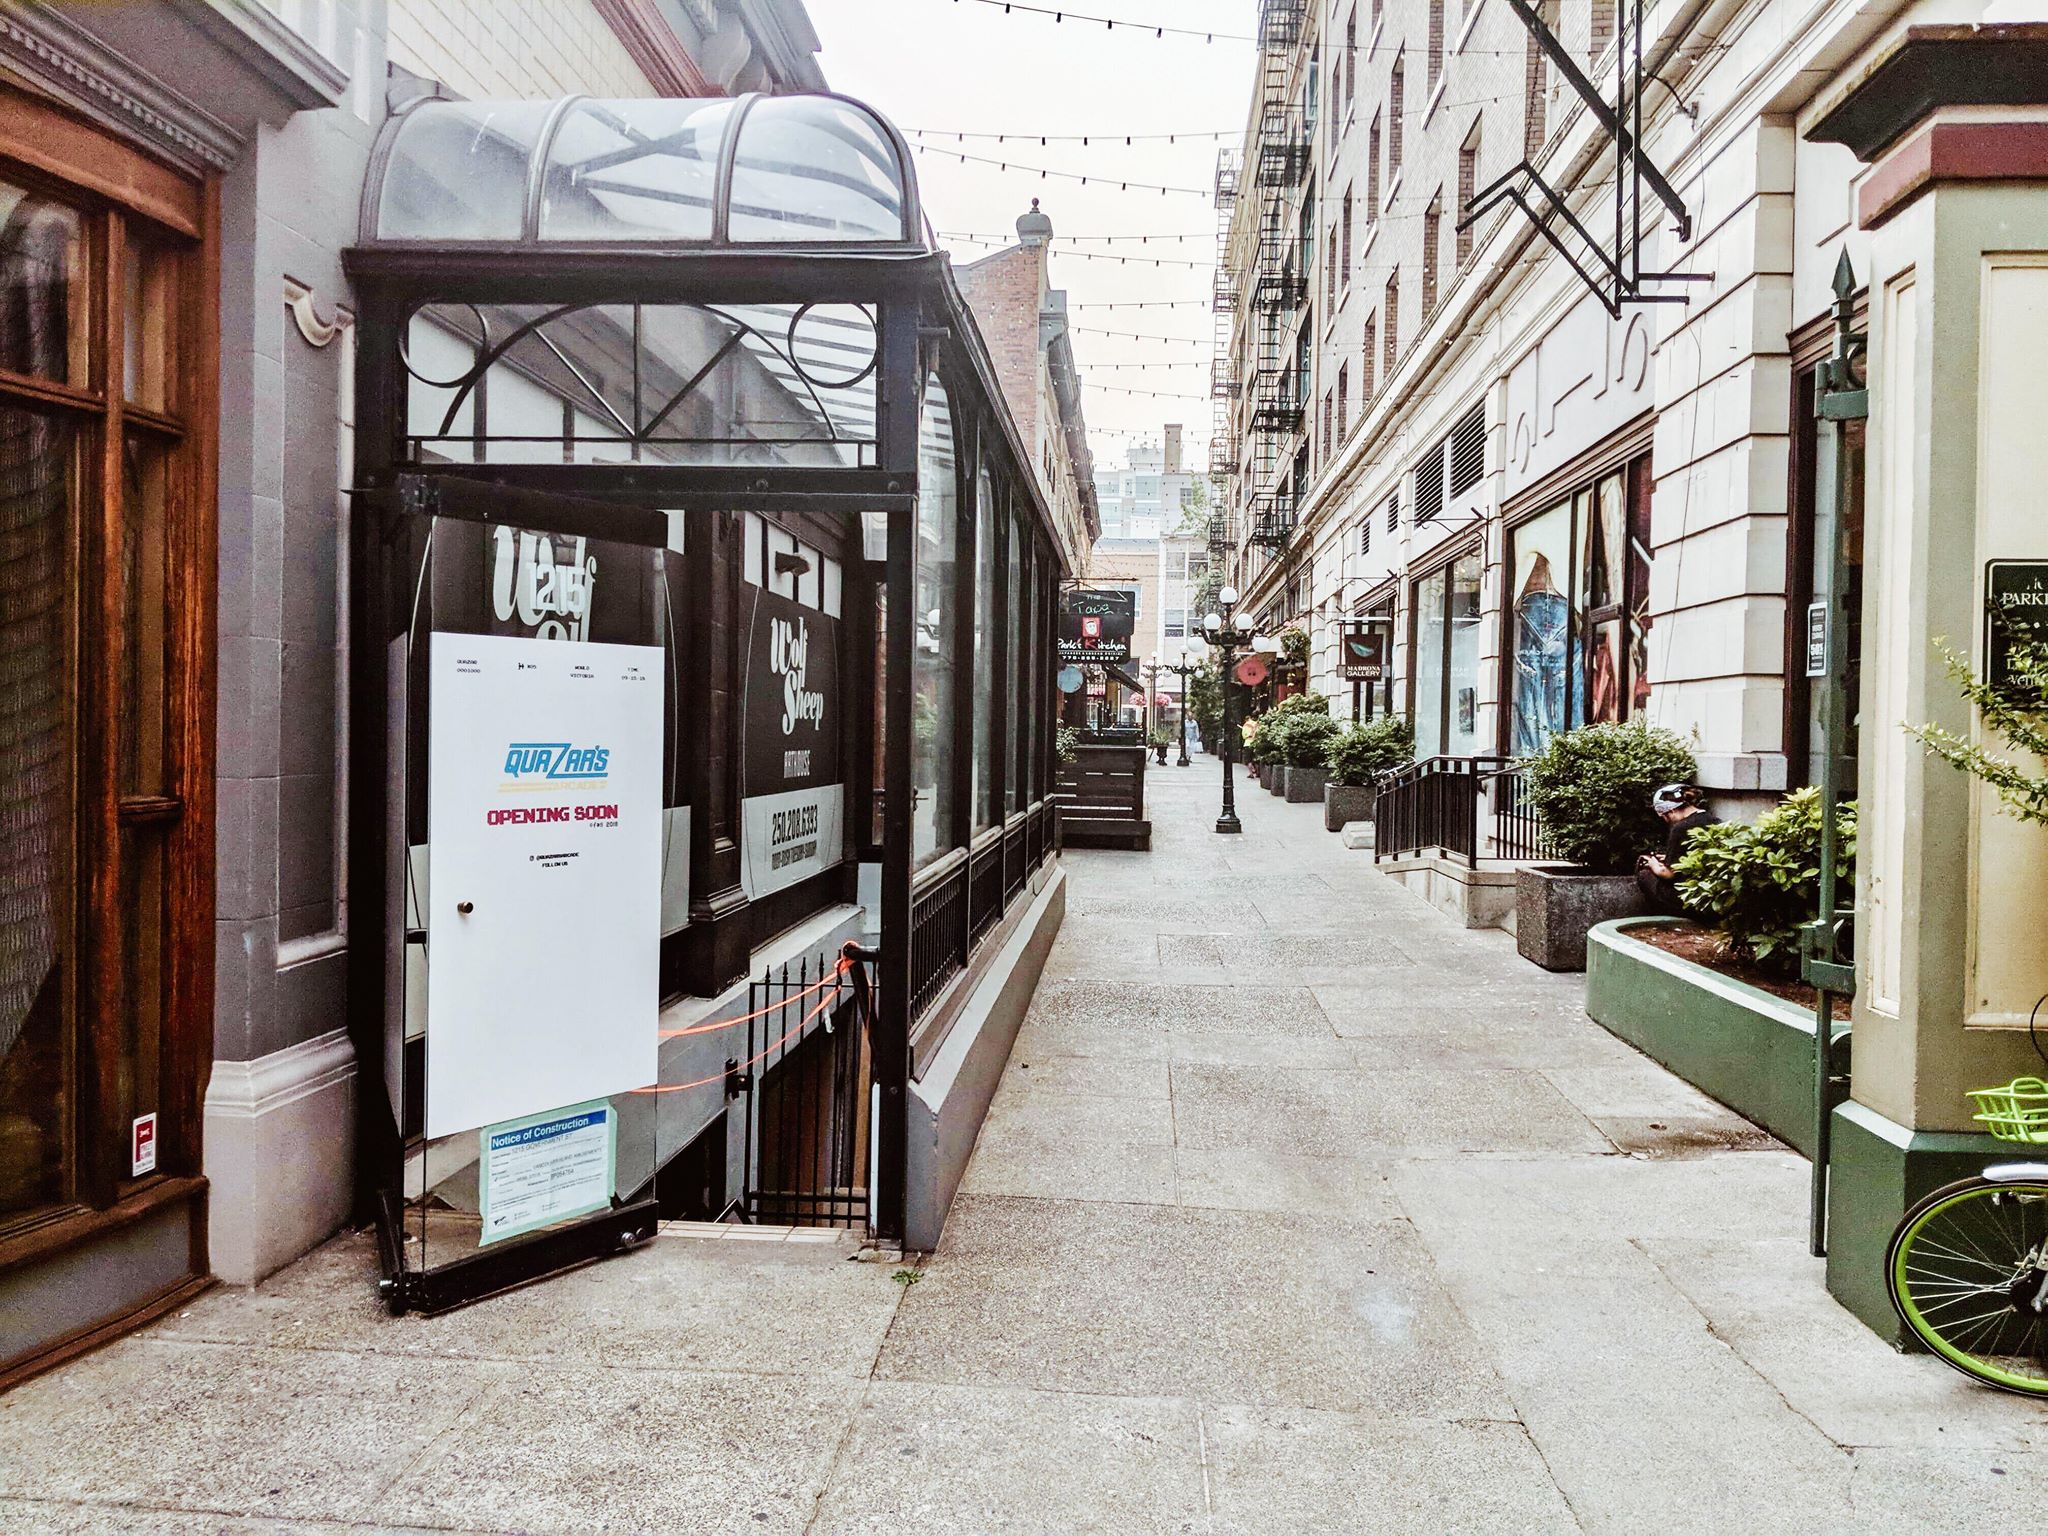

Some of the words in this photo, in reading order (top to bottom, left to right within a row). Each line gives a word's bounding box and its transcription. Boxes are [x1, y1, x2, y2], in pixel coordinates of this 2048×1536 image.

[526, 562, 586, 613] 1215
[770, 616, 808, 688] Wolf
[1084, 637, 1127, 652] Kitchen
[782, 669, 823, 736] Sheep
[487, 806, 570, 826] OPENING
[574, 804, 618, 820] SOON
[492, 1134, 521, 1148] Notice
[523, 1130, 533, 1141] of
[534, 1117, 589, 1138] Construction
